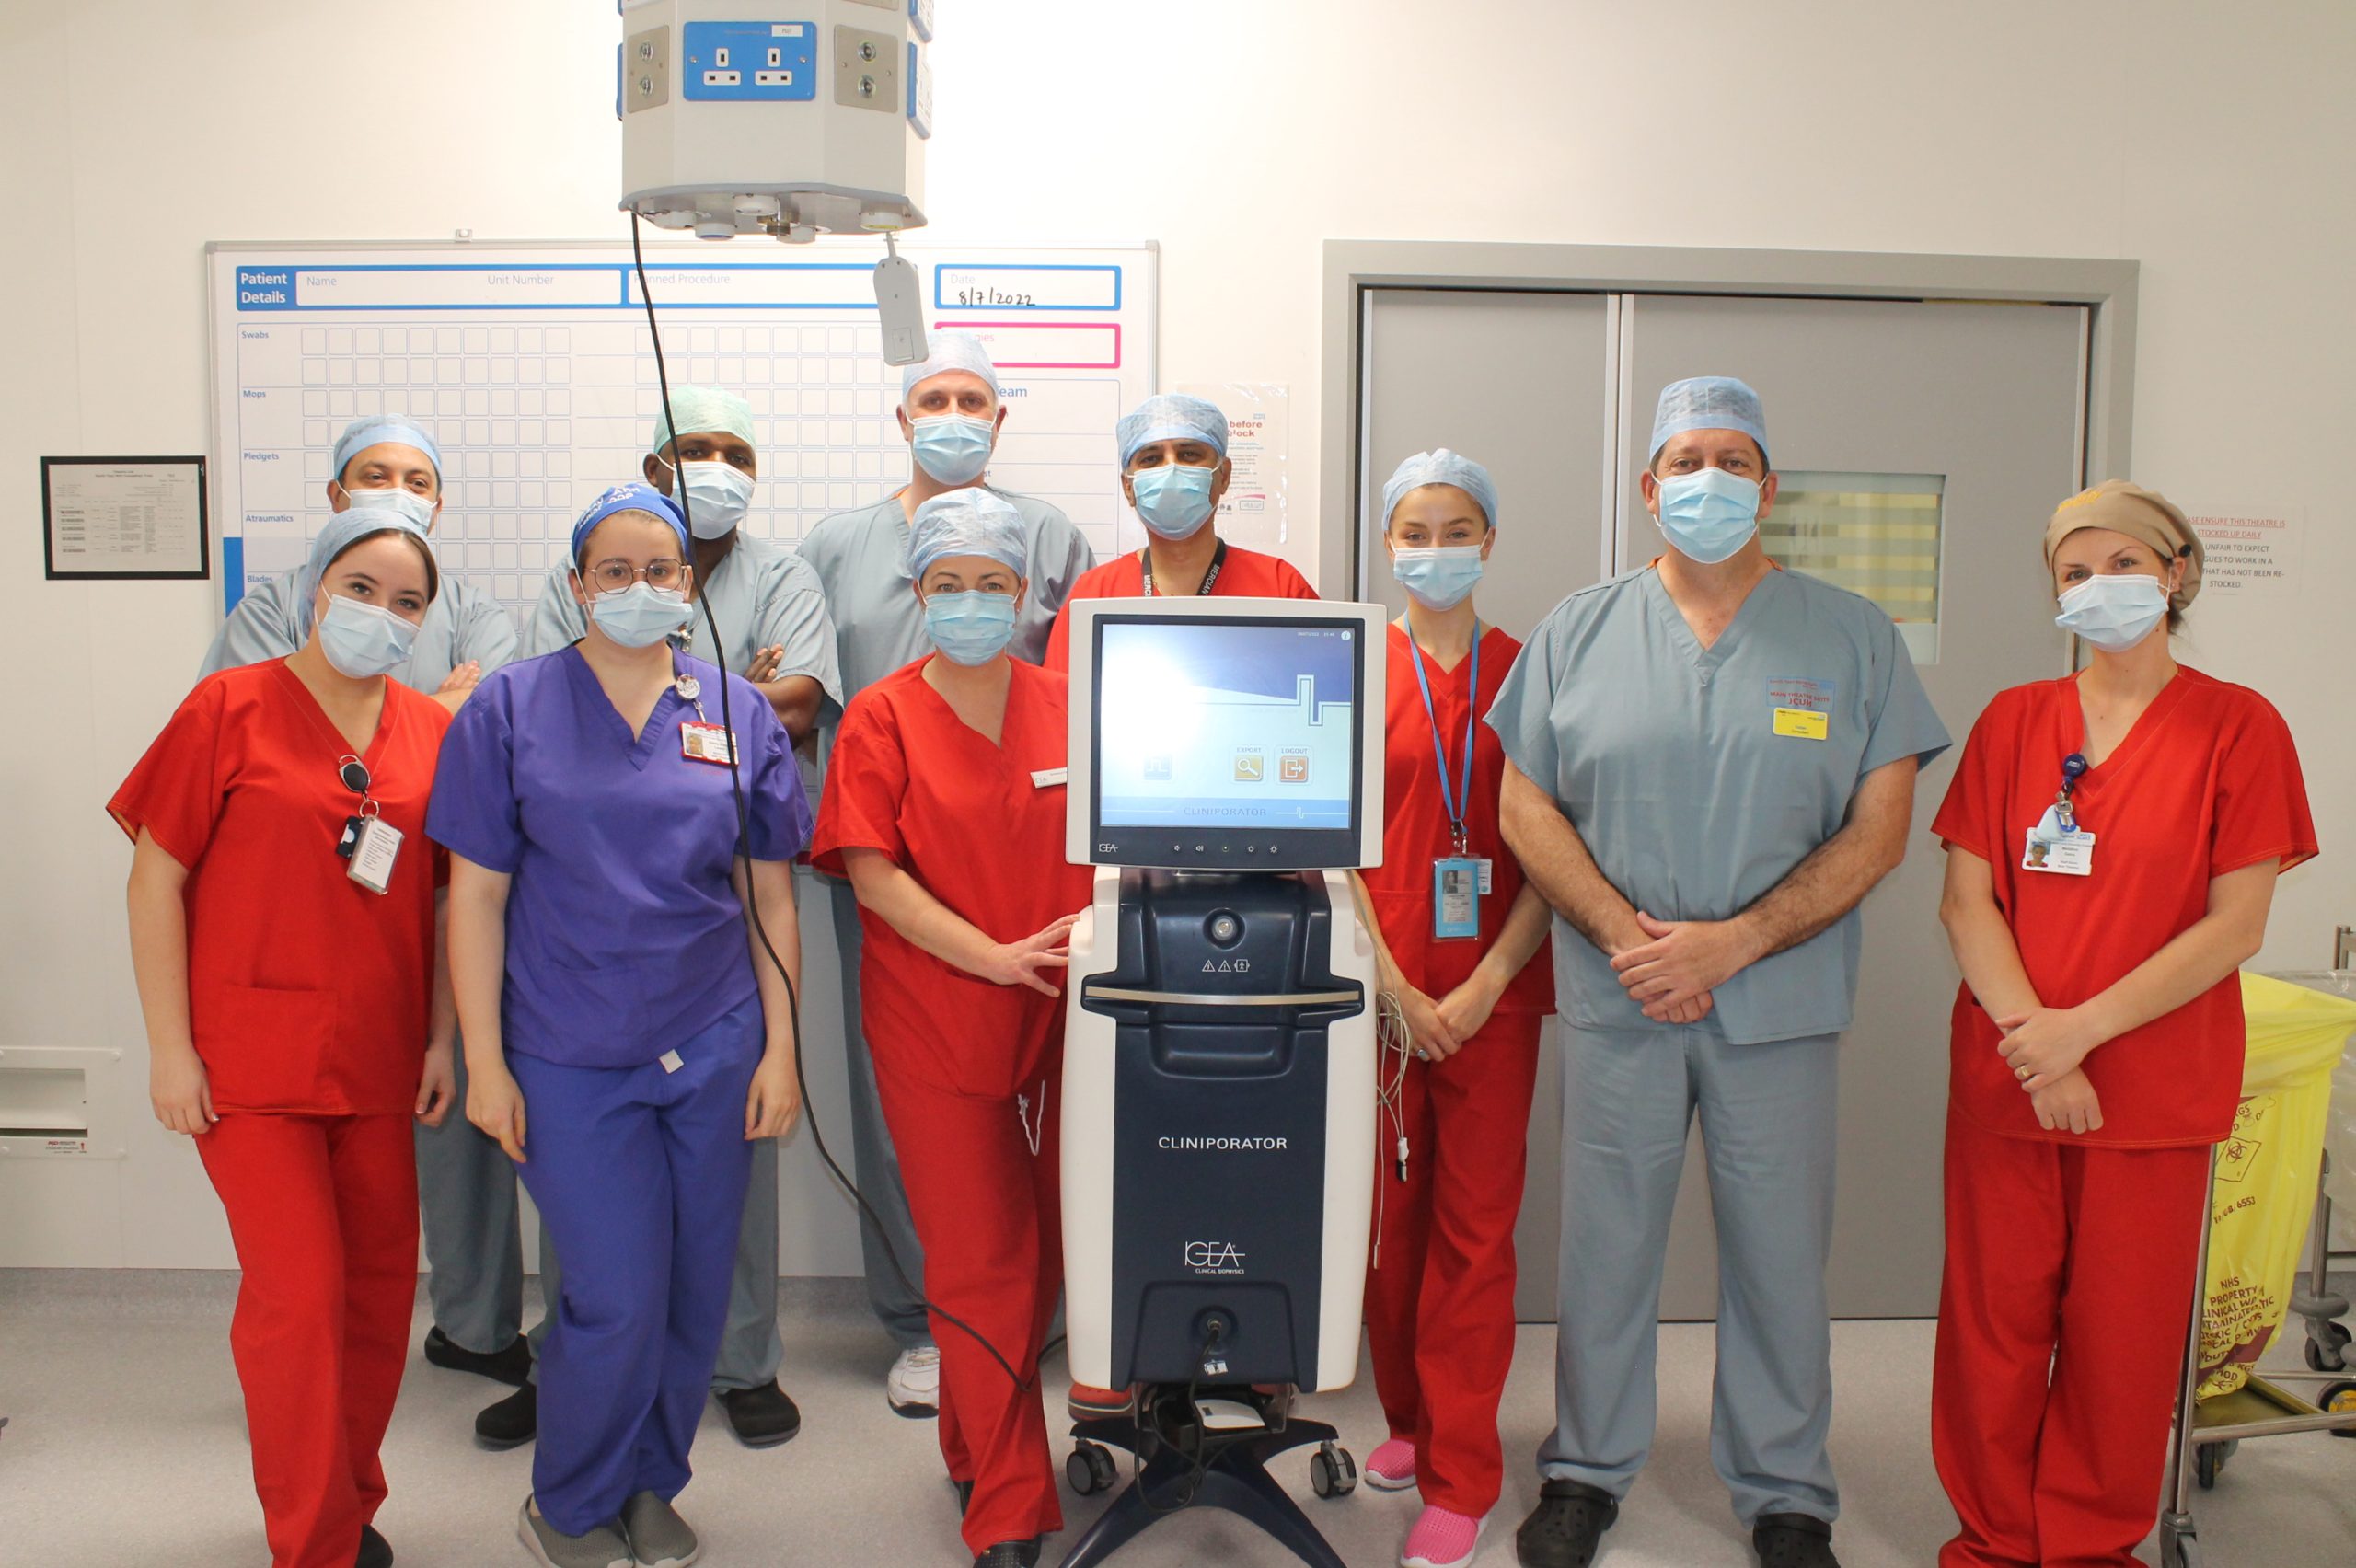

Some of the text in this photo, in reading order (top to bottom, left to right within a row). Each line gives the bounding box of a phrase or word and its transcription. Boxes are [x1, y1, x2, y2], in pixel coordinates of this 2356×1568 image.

[240, 272, 288, 285] Patient
[306, 274, 555, 286] Name Unit Number
[634, 273, 732, 285] Pnned Procedure
[950, 273, 976, 284] Date
[240, 290, 287, 304] Details
[958, 286, 1036, 307] 8/7/2022
[243, 390, 266, 398] Mops
[997, 386, 1028, 398] eam
[1230, 420, 1263, 428] before
[243, 452, 280, 462] Pledgets
[245, 514, 294, 523] Atraumatics
[2247, 519, 2279, 527] THEATRE
[2198, 529, 2229, 537] STOCKED
[247, 575, 273, 583] Blades
[1183, 806, 1268, 817] CLINIPORATOR
[1158, 1136, 1288, 1150] CLINIPORATOR
[1184, 1240, 1246, 1267] IGEA
[2220, 1276, 2240, 1290] NHS
[2210, 1285, 2258, 1307] PROPERTY
